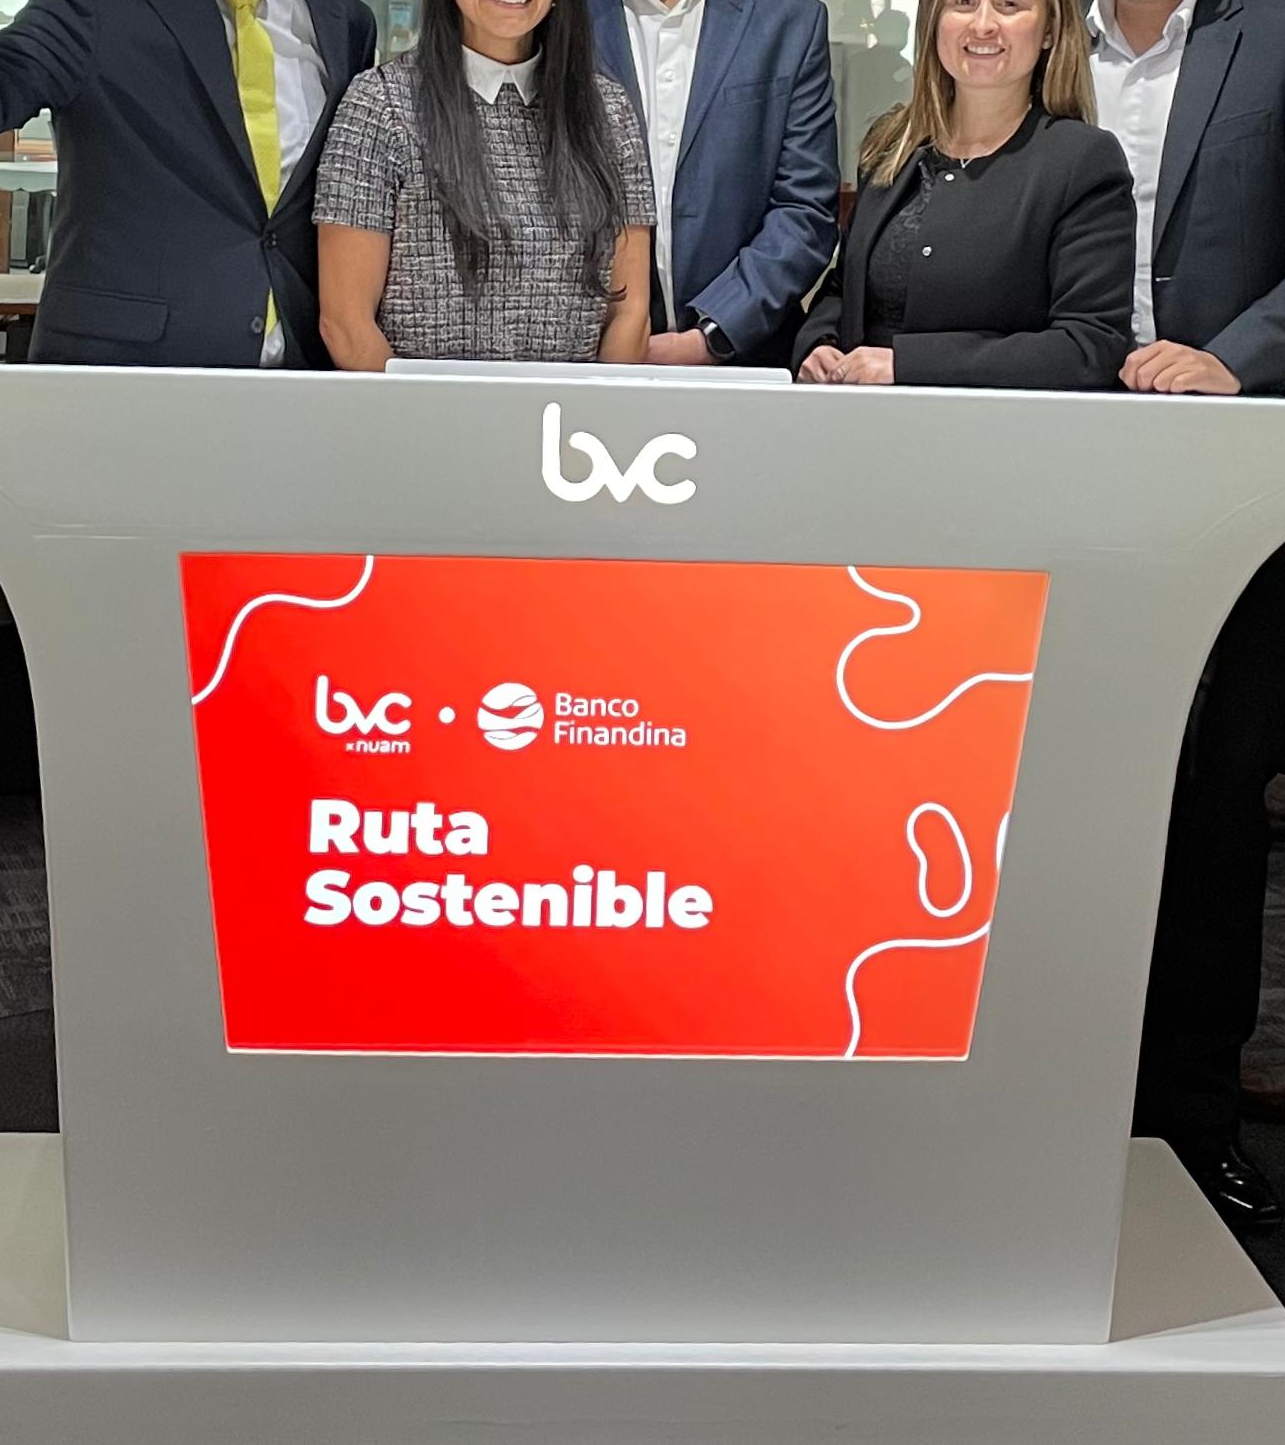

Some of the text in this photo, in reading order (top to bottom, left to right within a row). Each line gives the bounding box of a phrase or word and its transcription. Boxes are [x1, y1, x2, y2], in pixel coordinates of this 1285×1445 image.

[541, 402, 697, 504] bvc
[316, 675, 412, 735] bvc
[554, 720, 687, 748] Finandina
[555, 692, 639, 718] Banco
[309, 798, 489, 856] Ruta
[304, 863, 714, 929] Sostenible
